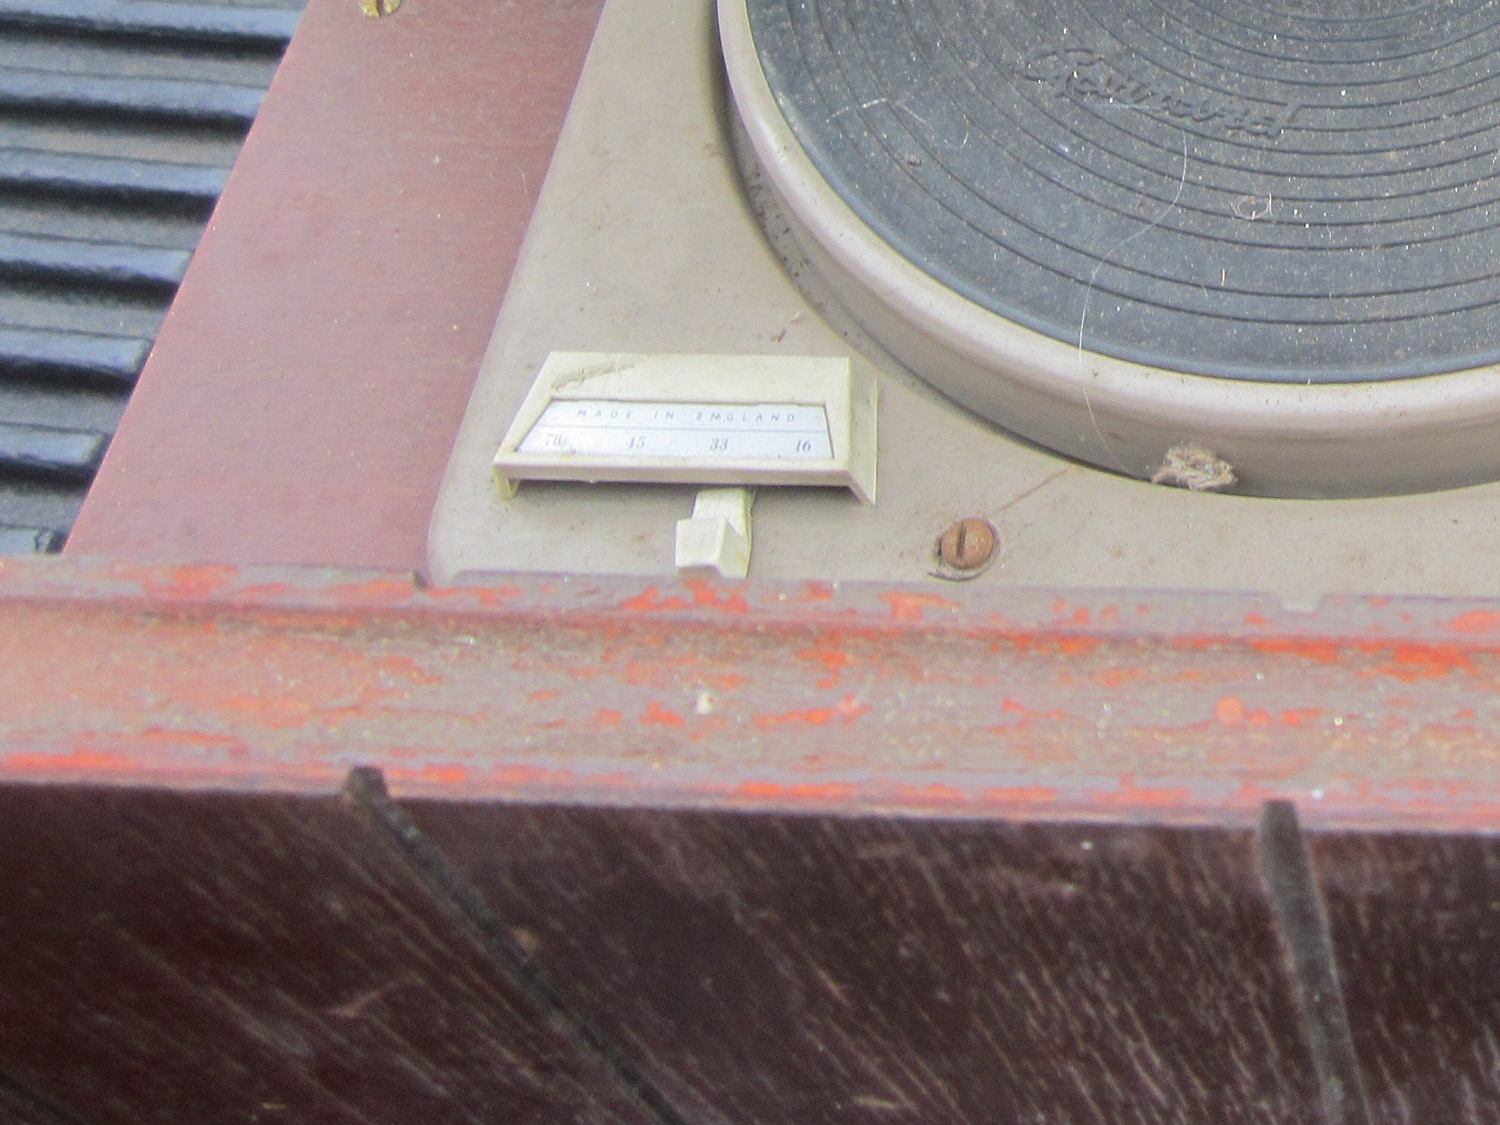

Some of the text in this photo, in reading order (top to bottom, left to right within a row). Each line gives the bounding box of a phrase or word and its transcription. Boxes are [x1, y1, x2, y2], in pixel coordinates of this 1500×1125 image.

[577, 409, 796, 423] MADE IN ENGLAND
[626, 435, 646, 449] 45
[709, 438, 729, 451] 33
[795, 439, 812, 452] 16
